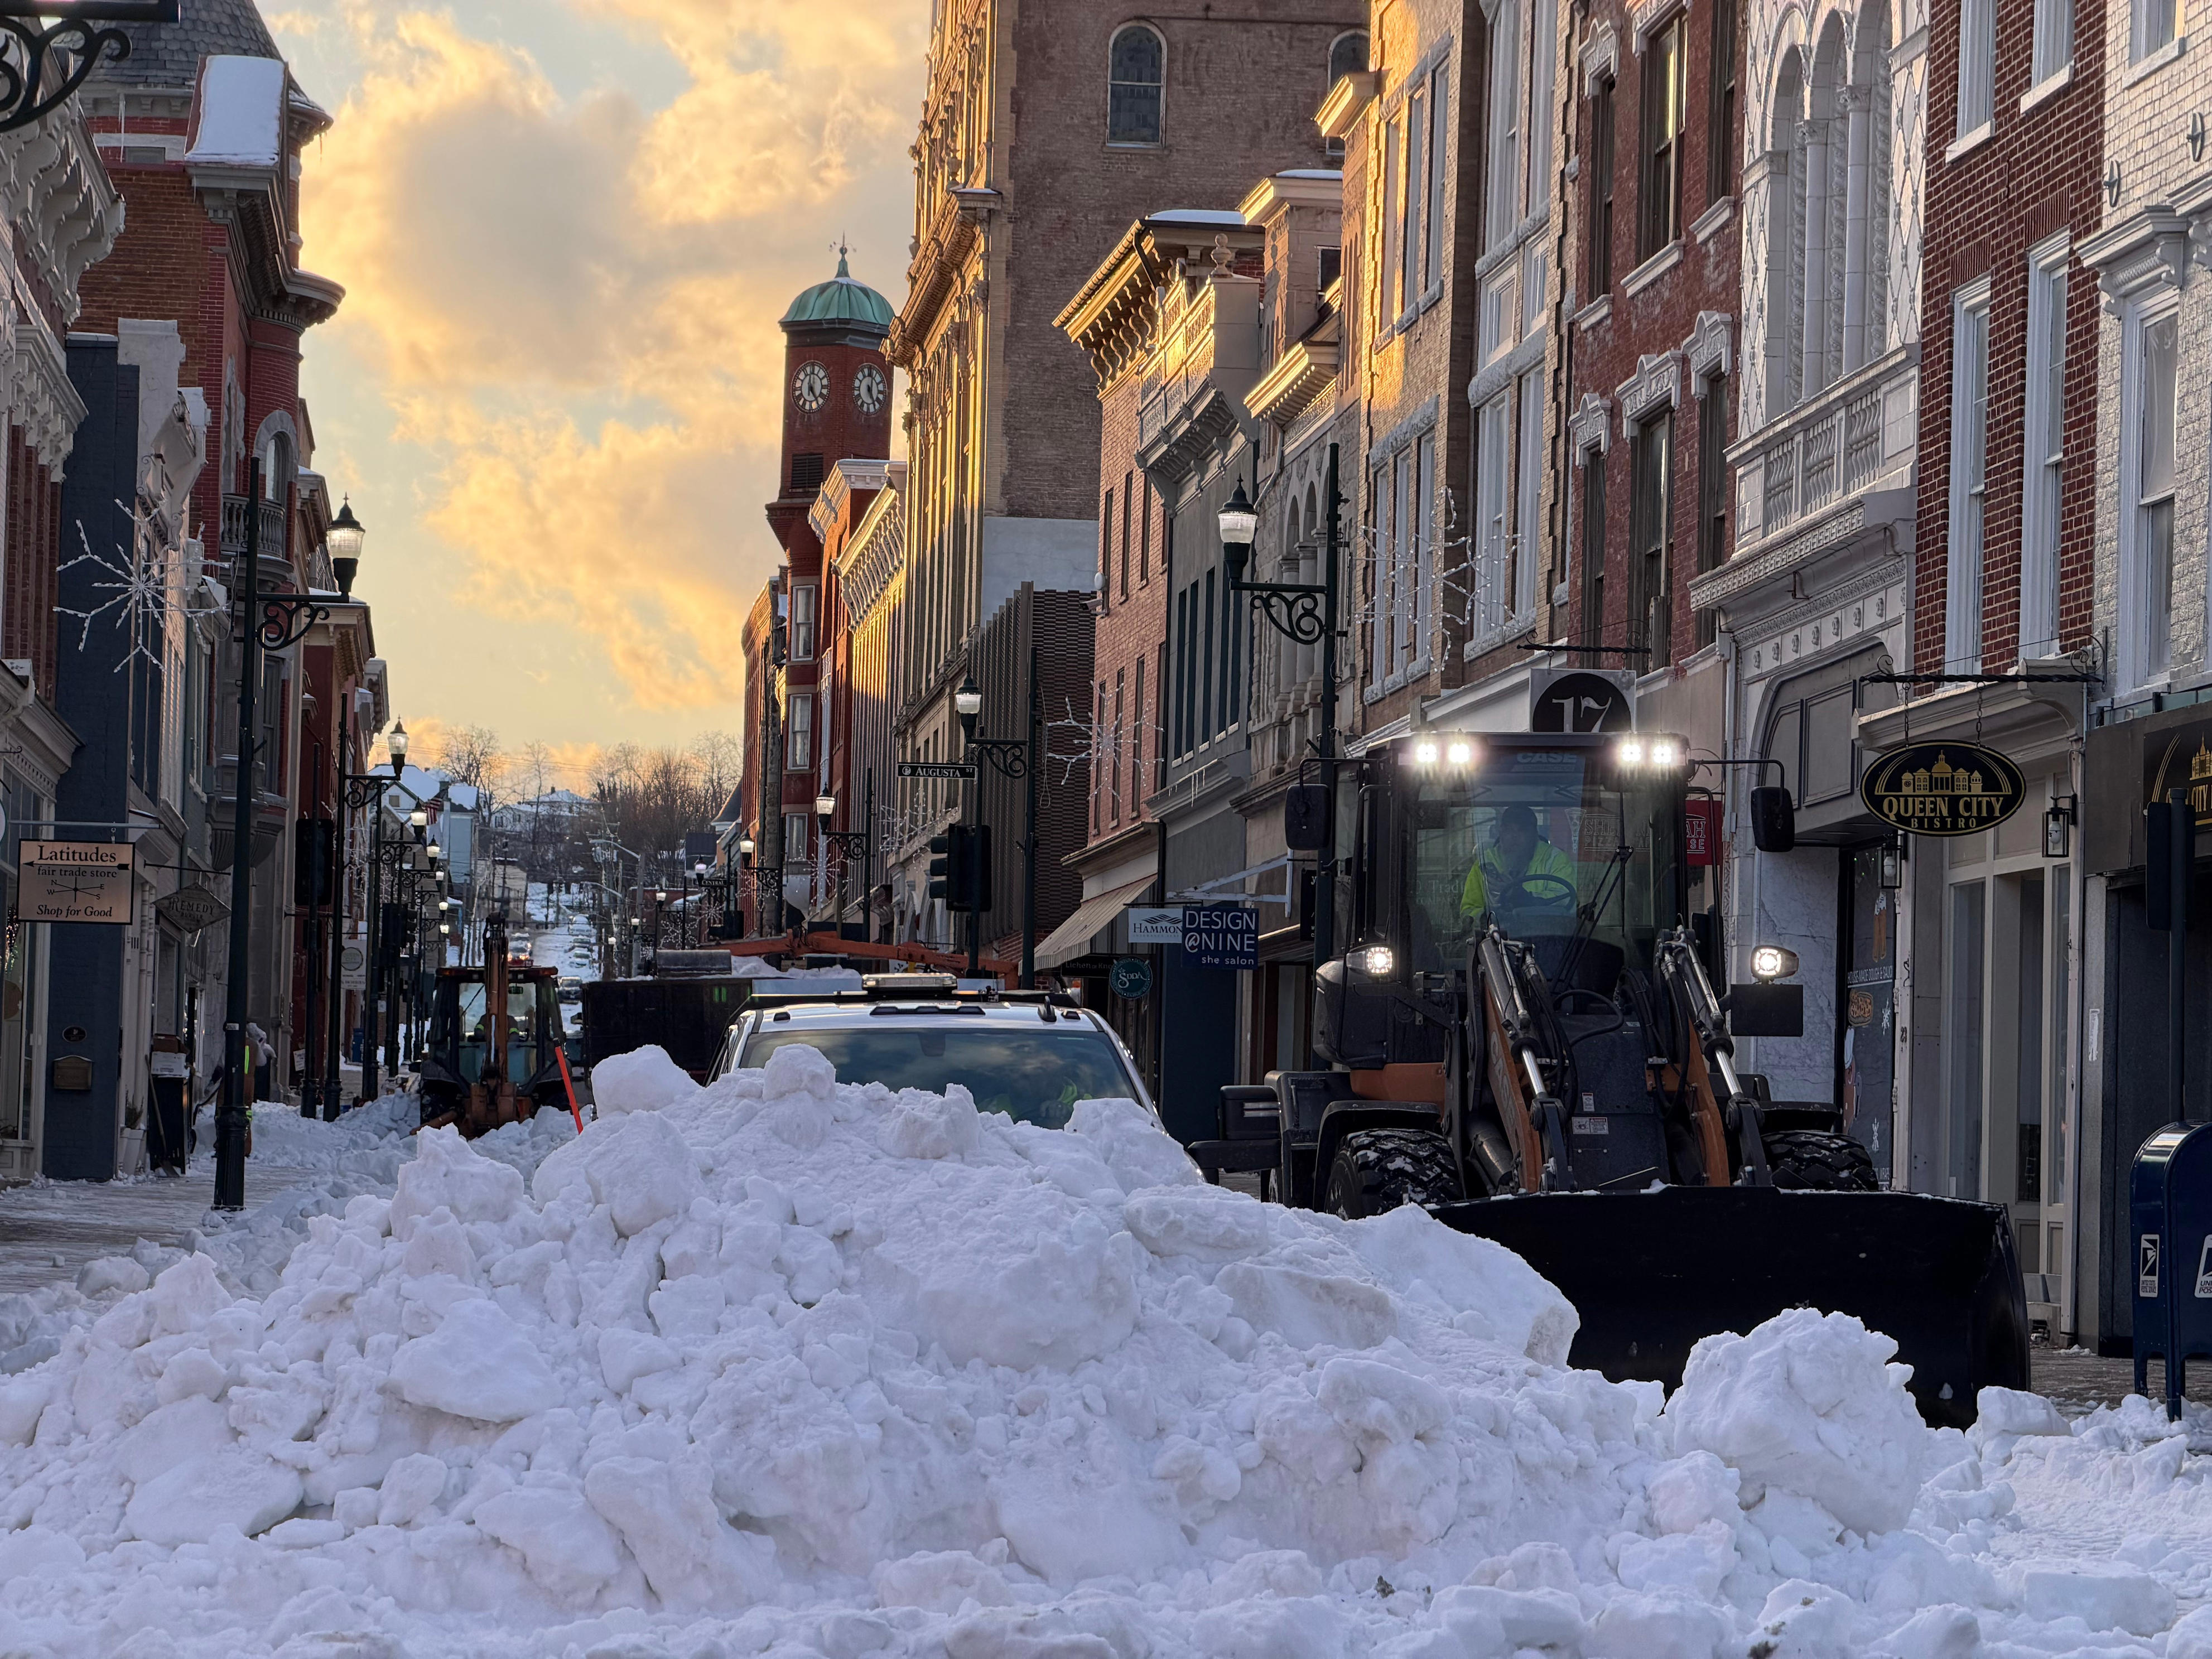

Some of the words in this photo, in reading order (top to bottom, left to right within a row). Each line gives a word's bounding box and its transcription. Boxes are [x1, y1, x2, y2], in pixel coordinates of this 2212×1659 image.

[1551, 696, 1612, 732] 17
[1517, 753, 1577, 763] CASE
[915, 766, 961, 777] AUGUSTA
[2191, 784, 2208, 812] CITY
[1882, 797, 1949, 821] QUEEN
[1959, 797, 2004, 817] CITY
[1911, 818, 1977, 828] BISTRO
[38, 845, 116, 862] Latitudes
[37, 866, 56, 875] fair
[60, 867, 87, 877] trade
[37, 905, 62, 918] Shop
[65, 905, 81, 918] for
[84, 906, 112, 917] Good
[170, 897, 214, 915] REMEDY
[1134, 923, 1183, 934] HAMMON
[1185, 910, 1255, 930] DESIGN
[1185, 932, 1255, 953] @NINE
[1201, 954, 1220, 964] she
[1225, 956, 1254, 965] salon
[1491, 1031, 1515, 1129] CASE
